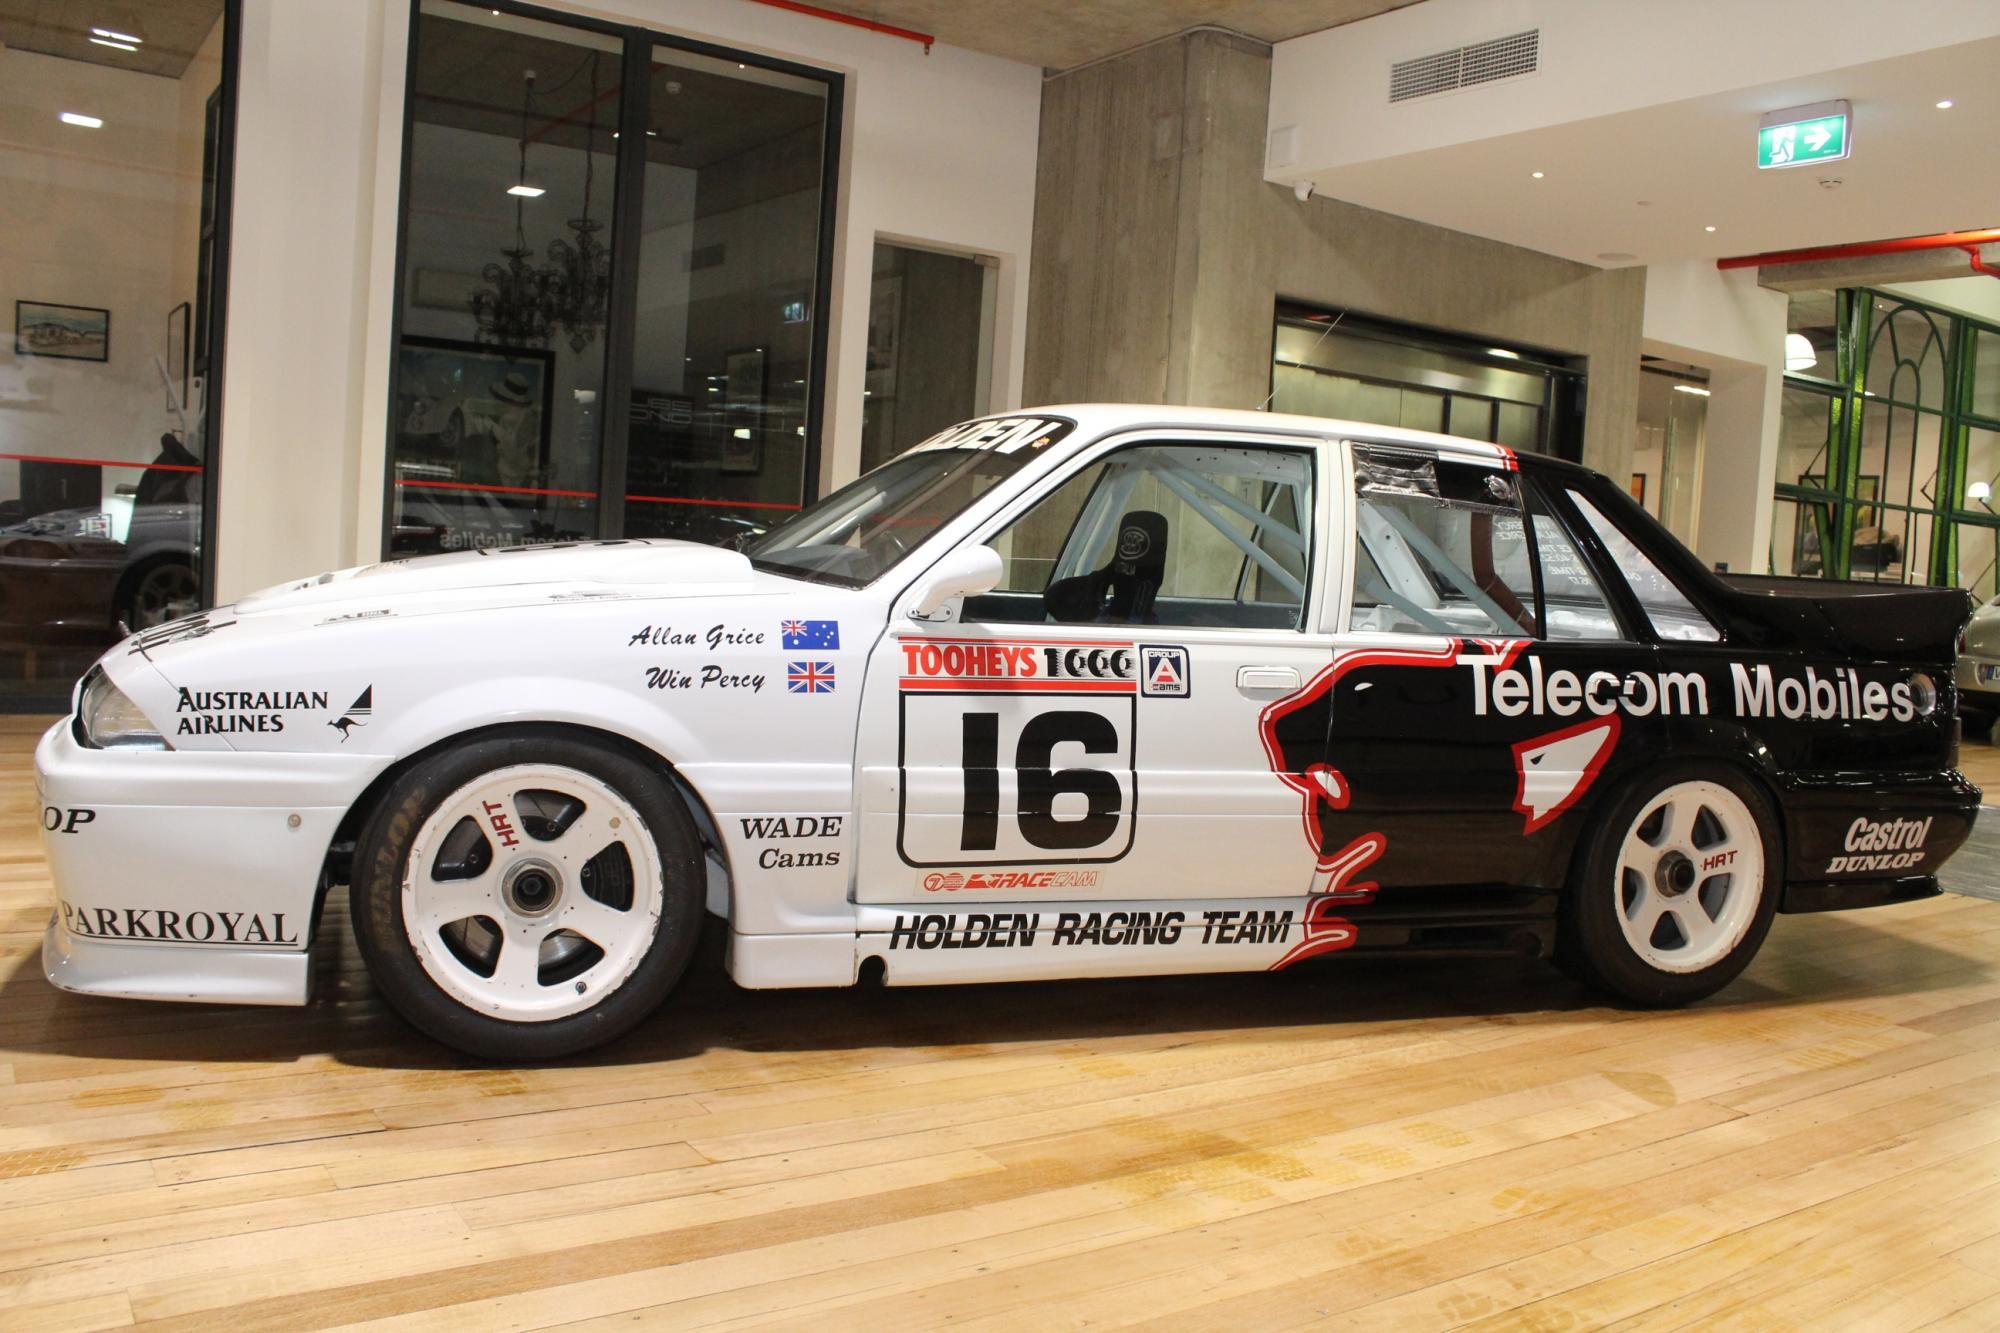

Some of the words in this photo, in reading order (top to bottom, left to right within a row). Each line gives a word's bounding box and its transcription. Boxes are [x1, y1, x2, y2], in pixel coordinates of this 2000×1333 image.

[628, 625, 697, 647] Allan
[705, 624, 765, 650] Grice
[902, 645, 1037, 677] TOOHEYS
[1043, 648, 1134, 677] 1000
[645, 667, 692, 690] Win
[700, 665, 766, 692] Percy
[1456, 655, 1709, 717] Telecom
[1730, 663, 1915, 722] Mobiles
[176, 686, 328, 713] AUSTRALIAN
[177, 714, 284, 735] AIRLINES
[960, 710, 1122, 850] 16
[482, 800, 520, 848] HRT
[740, 816, 842, 839] WADE
[1844, 816, 1933, 852] Castrol
[758, 848, 840, 869] Cams
[1703, 850, 1738, 871] HRT
[1825, 852, 1925, 873] DUNLOP
[62, 900, 298, 942] PARKROYAL
[889, 913, 1039, 950] HOLDEN
[1052, 911, 1186, 946] RACING
[1202, 911, 1294, 944] TEAM
